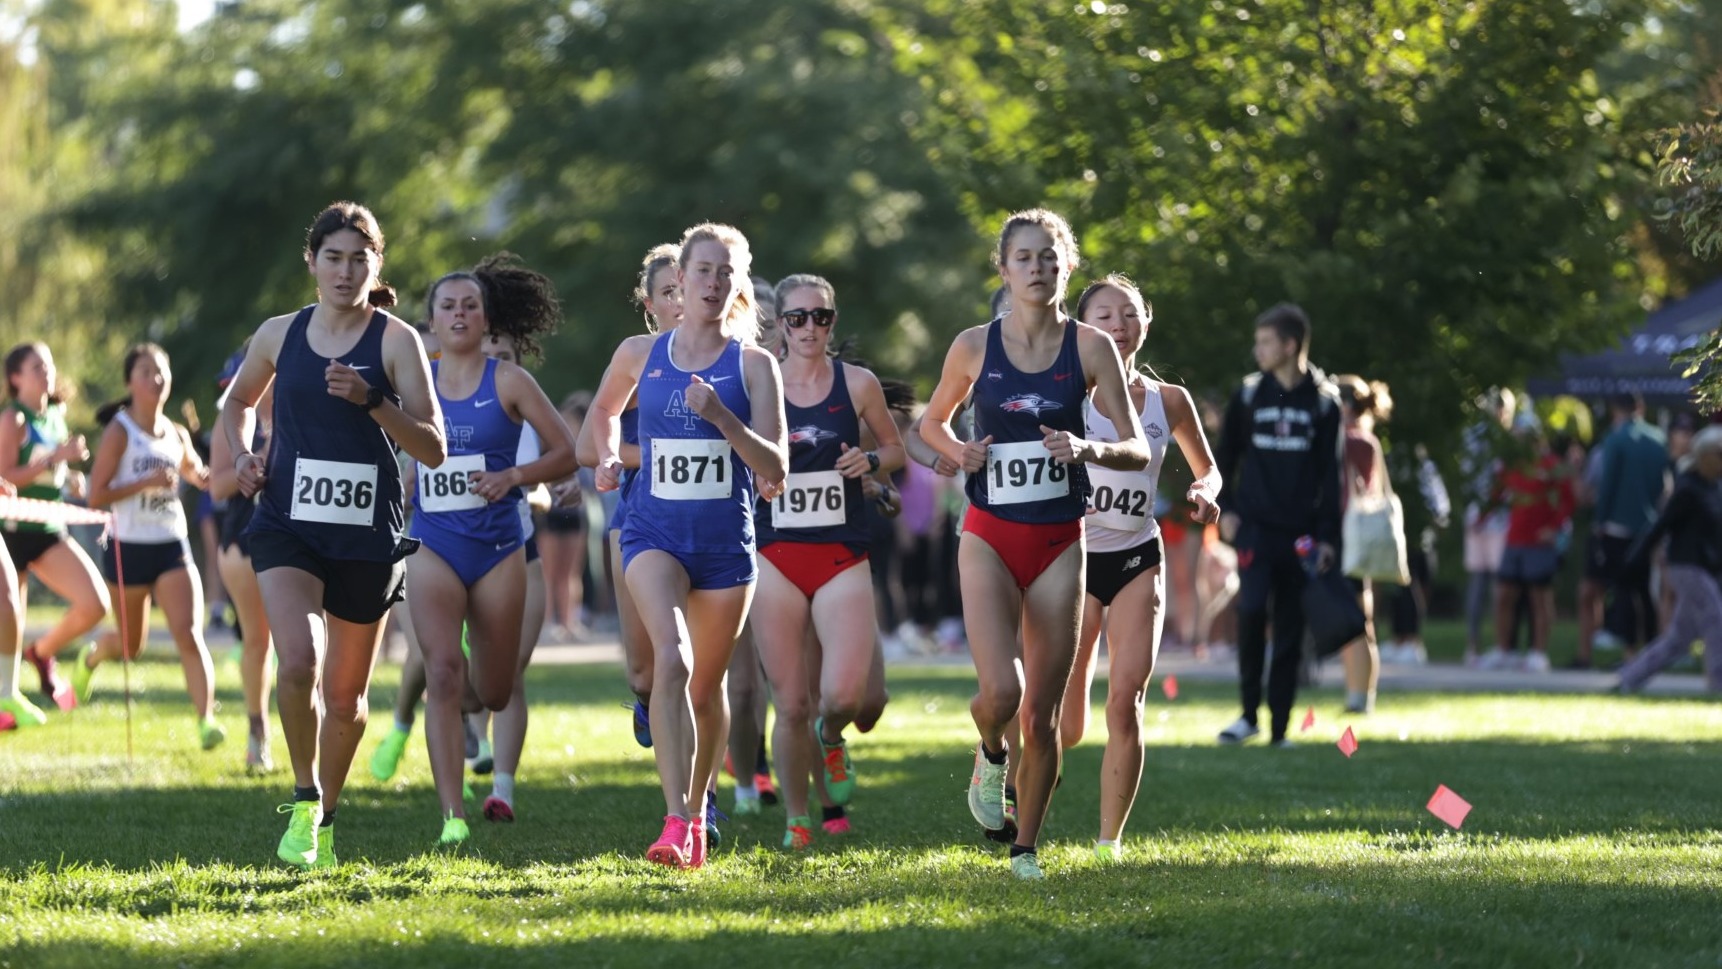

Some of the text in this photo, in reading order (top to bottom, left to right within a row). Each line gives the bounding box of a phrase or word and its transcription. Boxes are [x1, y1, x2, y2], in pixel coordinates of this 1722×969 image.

[658, 455, 725, 484] 1871
[994, 457, 1066, 488] 1978
[299, 475, 373, 510] 2036
[779, 485, 842, 513] 1976
[1086, 485, 1147, 517] 042
